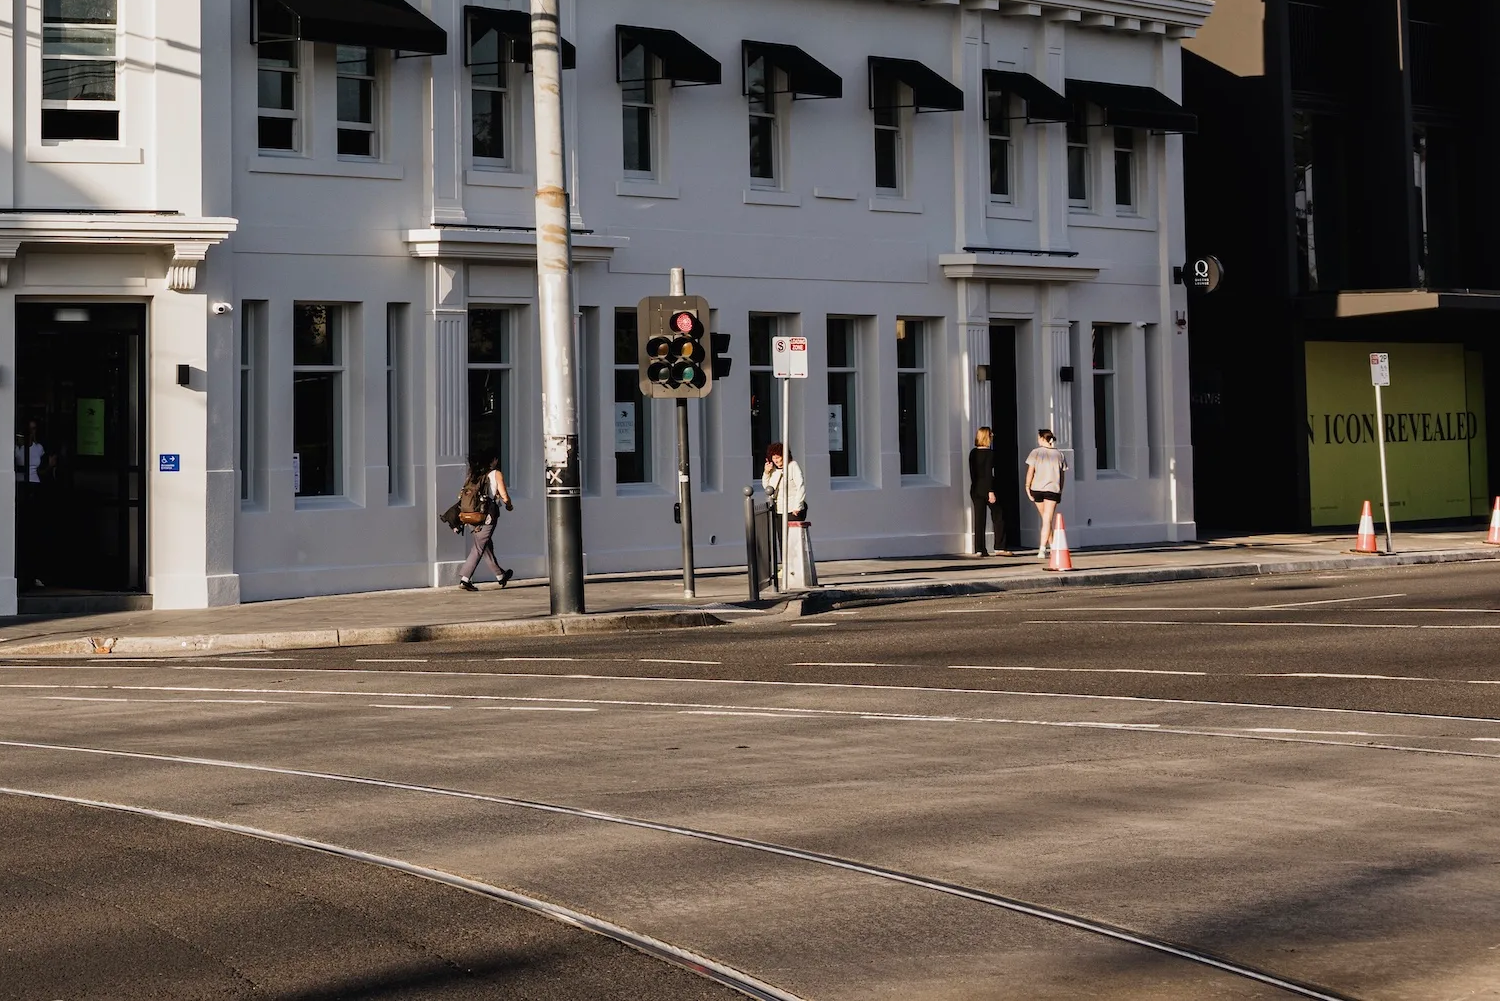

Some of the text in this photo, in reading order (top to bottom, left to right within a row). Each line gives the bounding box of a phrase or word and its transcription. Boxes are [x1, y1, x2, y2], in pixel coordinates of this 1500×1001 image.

[1195, 260, 1209, 277] Q
[1324, 413, 1375, 444] ICON
[1384, 411, 1477, 443] REVEALED
